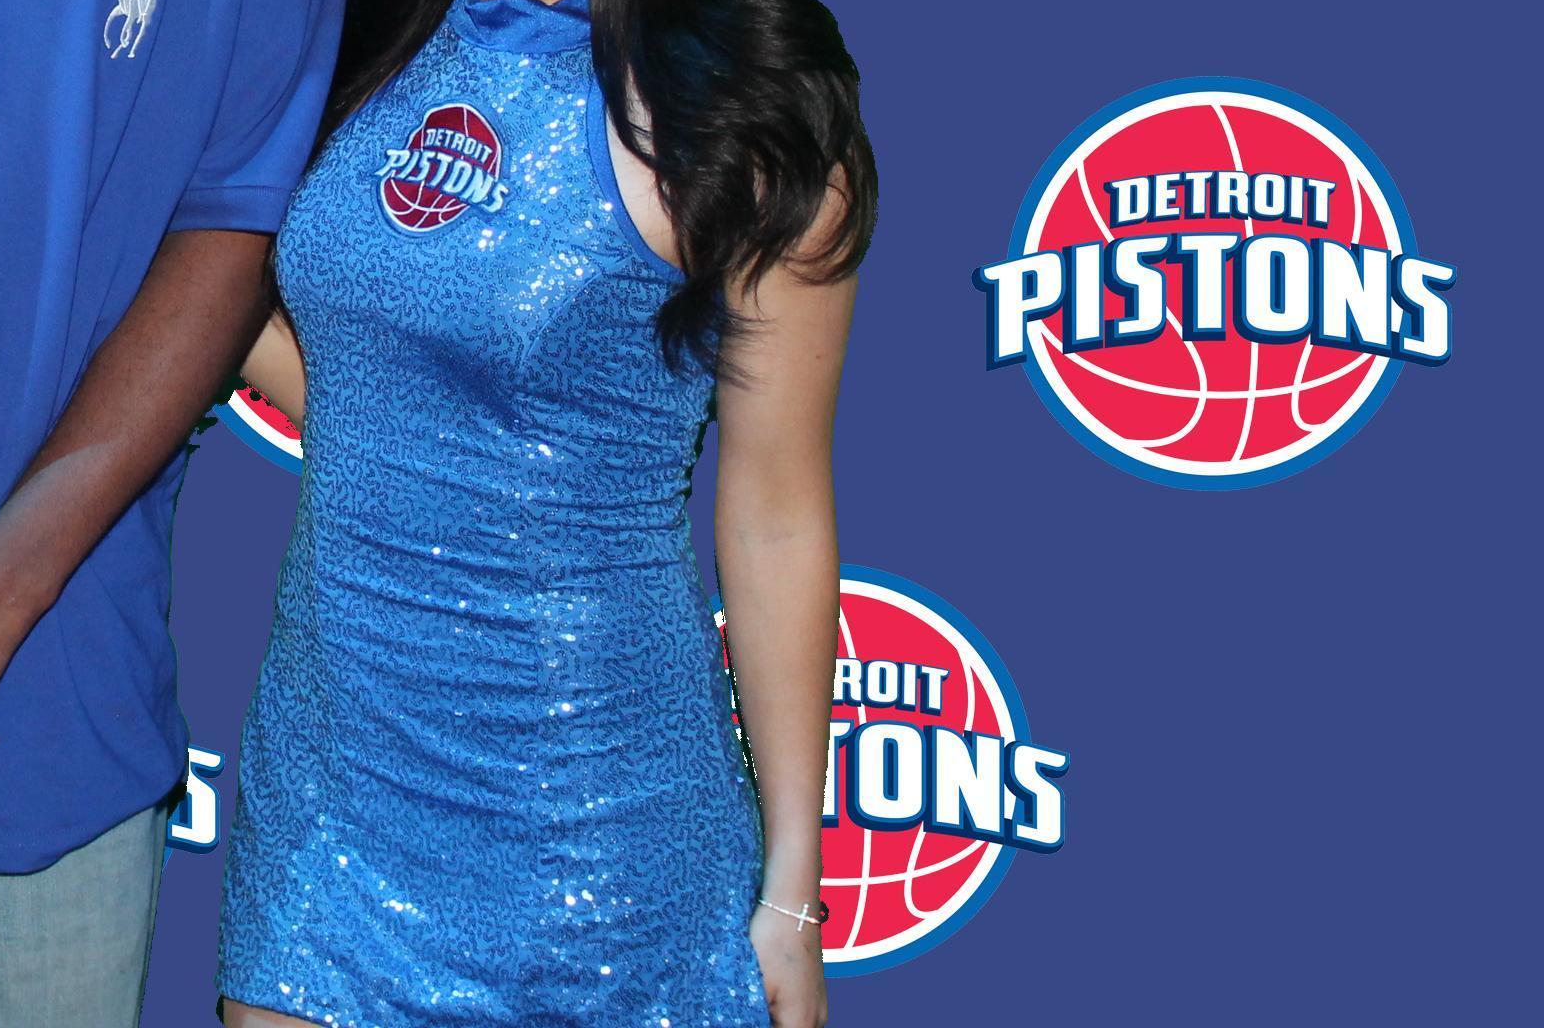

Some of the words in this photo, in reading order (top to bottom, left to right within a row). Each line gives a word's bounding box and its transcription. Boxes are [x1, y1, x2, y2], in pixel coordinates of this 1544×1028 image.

[424, 127, 494, 166] DETROIT
[374, 149, 510, 214] PISTONS
[1104, 170, 1337, 229] DETROIT
[971, 232, 1457, 371] PISTONS
[833, 658, 950, 716] ROIT
